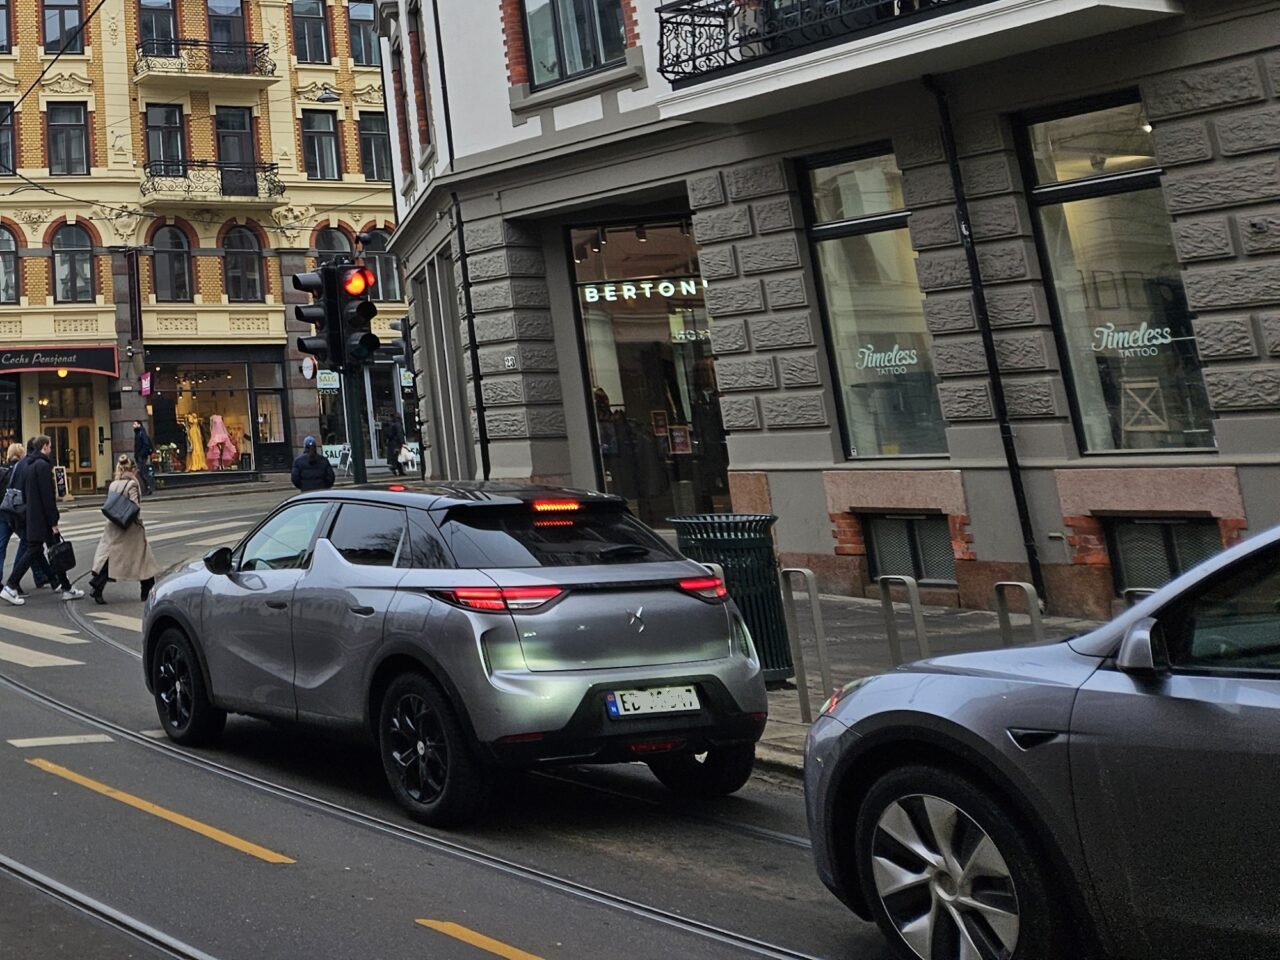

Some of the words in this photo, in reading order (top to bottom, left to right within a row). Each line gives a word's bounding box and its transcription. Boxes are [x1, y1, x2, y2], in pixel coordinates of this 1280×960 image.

[1091, 322, 1172, 351] Timeless
[31, 352, 77, 366] Pensjonat
[855, 344, 918, 369] Timeless
[1118, 346, 1158, 358] TATTOO
[875, 366, 907, 375] TATTOO
